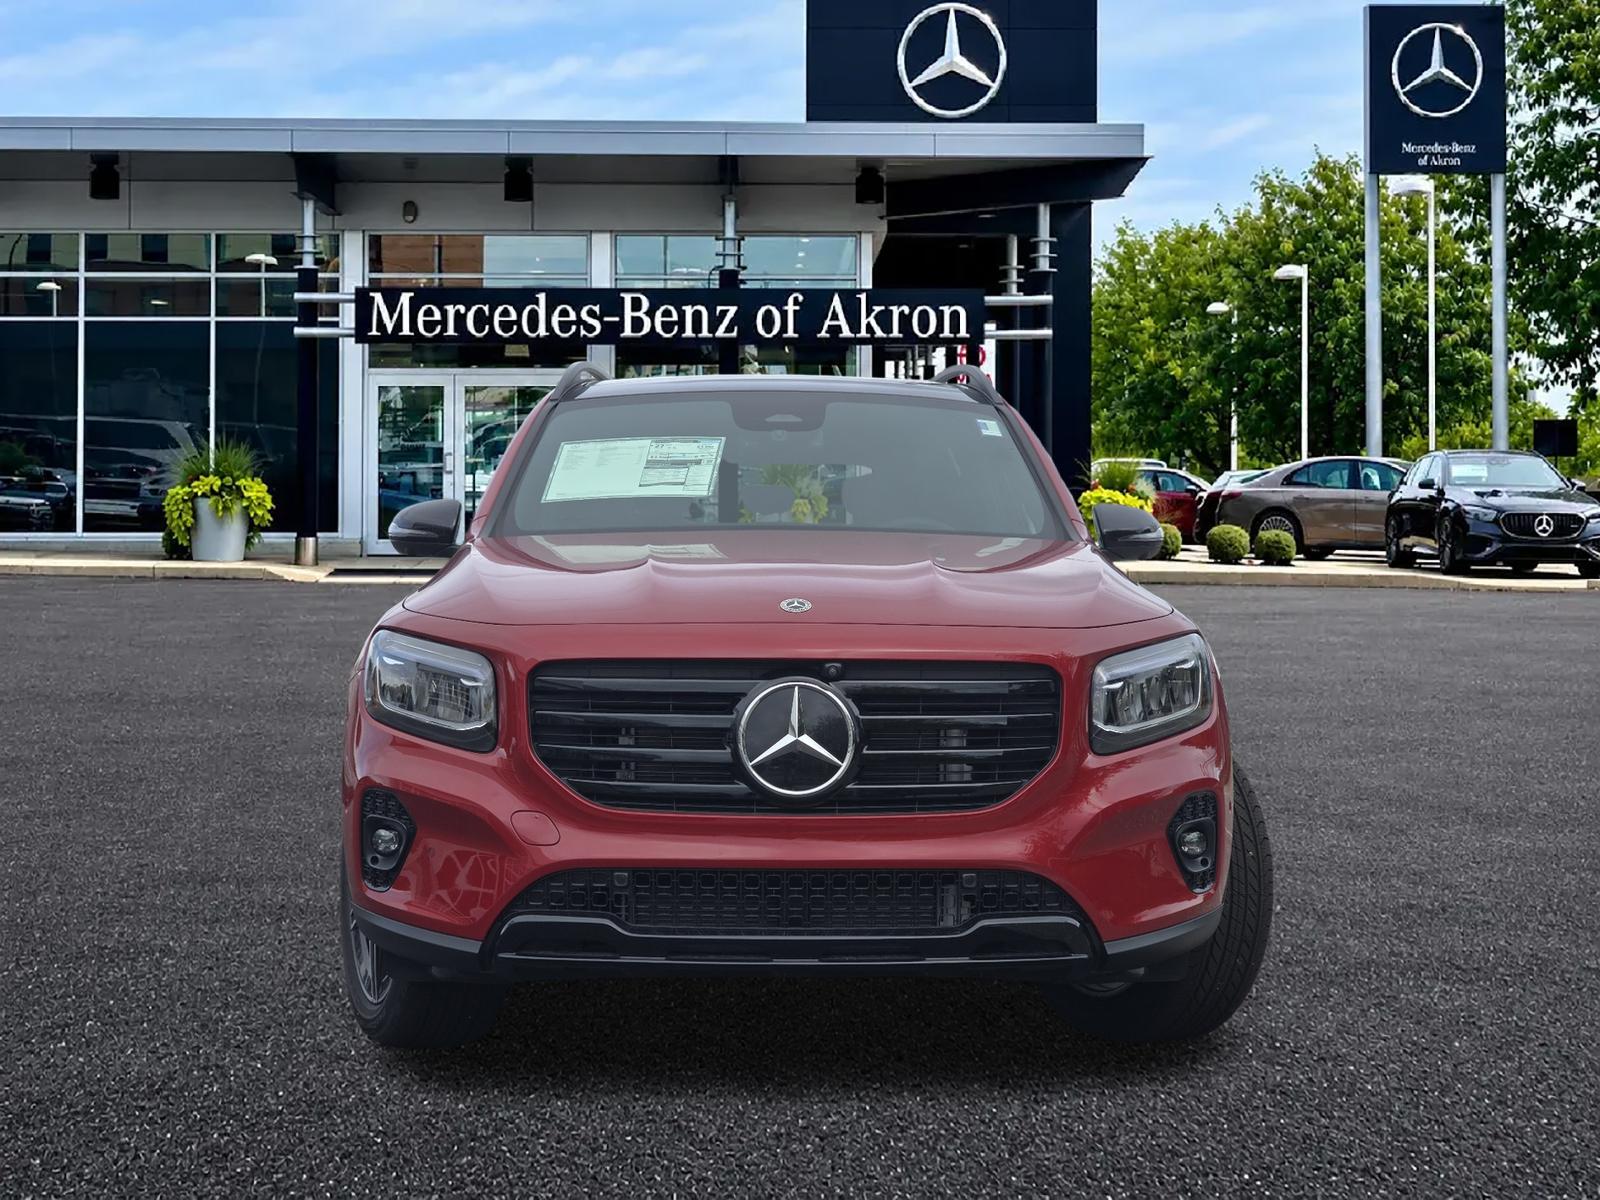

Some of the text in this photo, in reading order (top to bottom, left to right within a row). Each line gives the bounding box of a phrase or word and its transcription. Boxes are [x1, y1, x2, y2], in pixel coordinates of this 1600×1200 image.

[1402, 142, 1476, 153] Mercedes-Benz
[1418, 155, 1461, 166] of Akron
[368, 291, 971, 338] Mercedes-Benz of Akron
